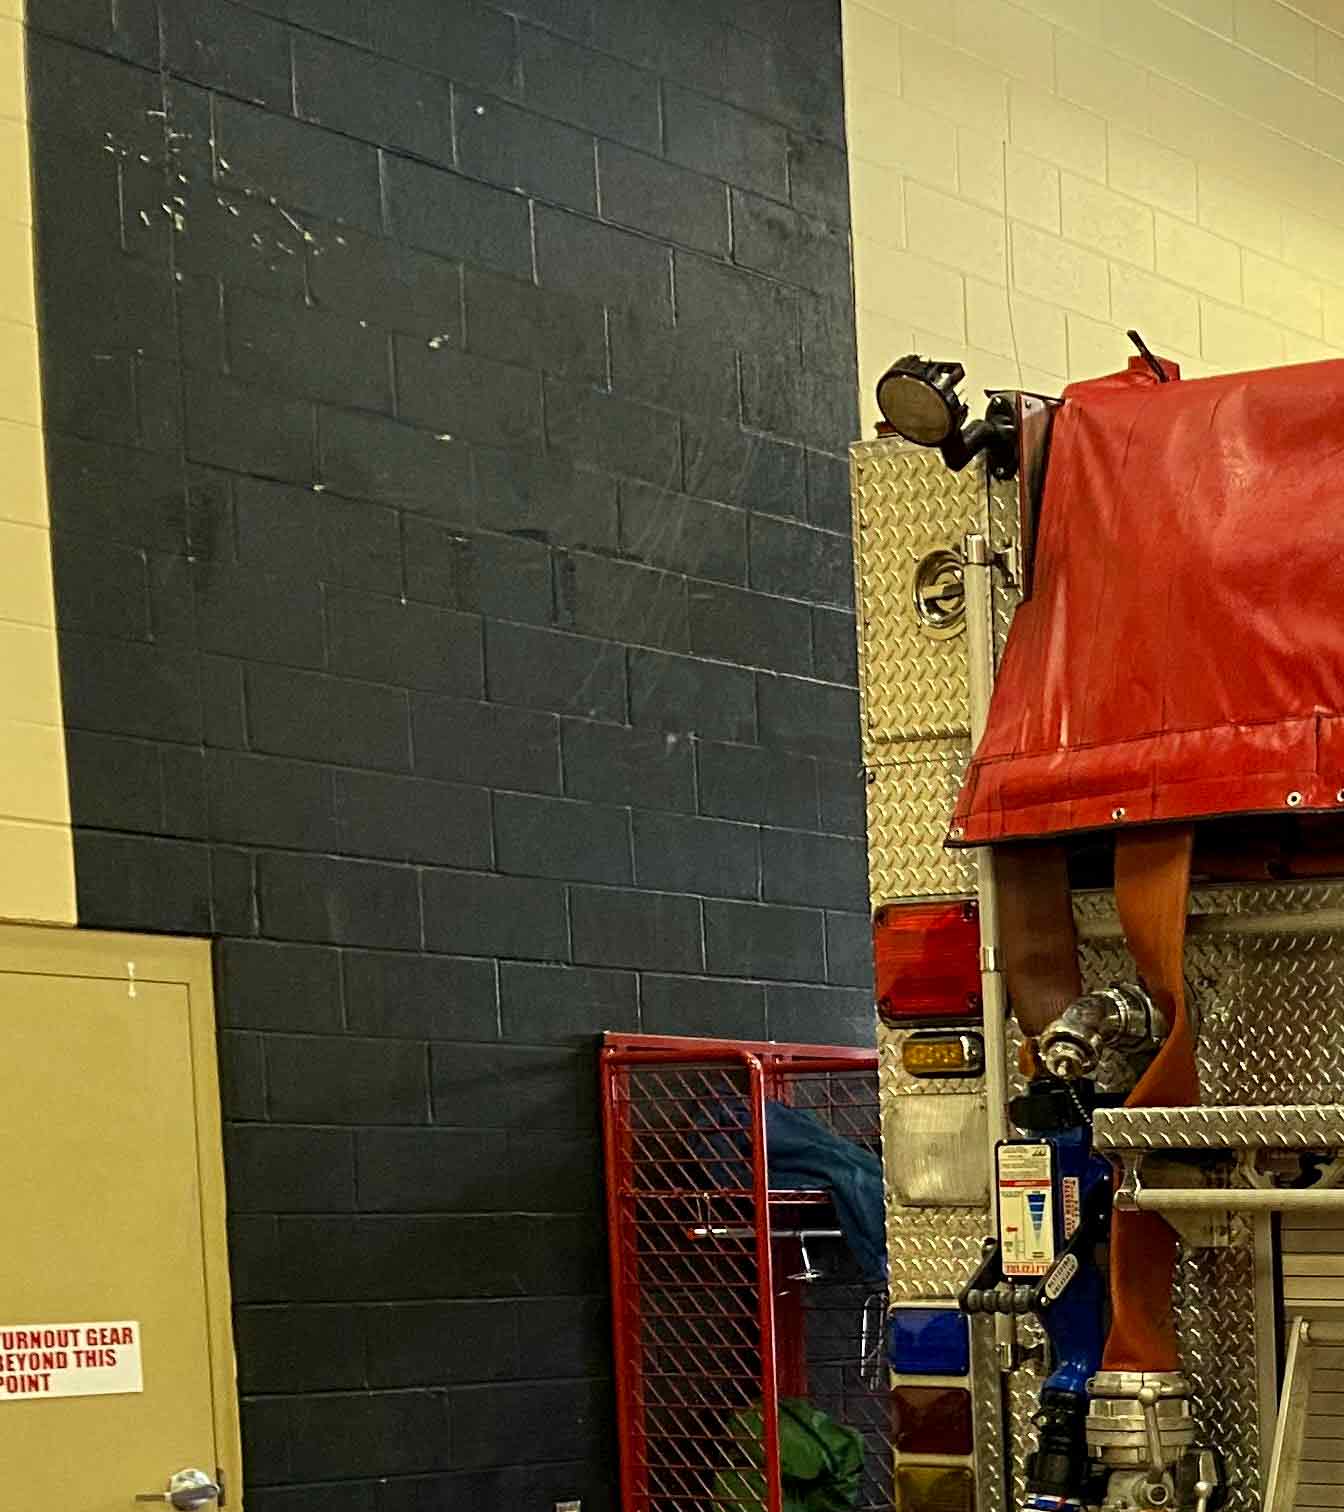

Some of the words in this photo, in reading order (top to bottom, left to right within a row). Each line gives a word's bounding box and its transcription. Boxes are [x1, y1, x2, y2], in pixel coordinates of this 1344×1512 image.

[0, 1329, 80, 1350] URNOUT
[86, 1327, 133, 1346] GEAR
[73, 1349, 117, 1368] THIS
